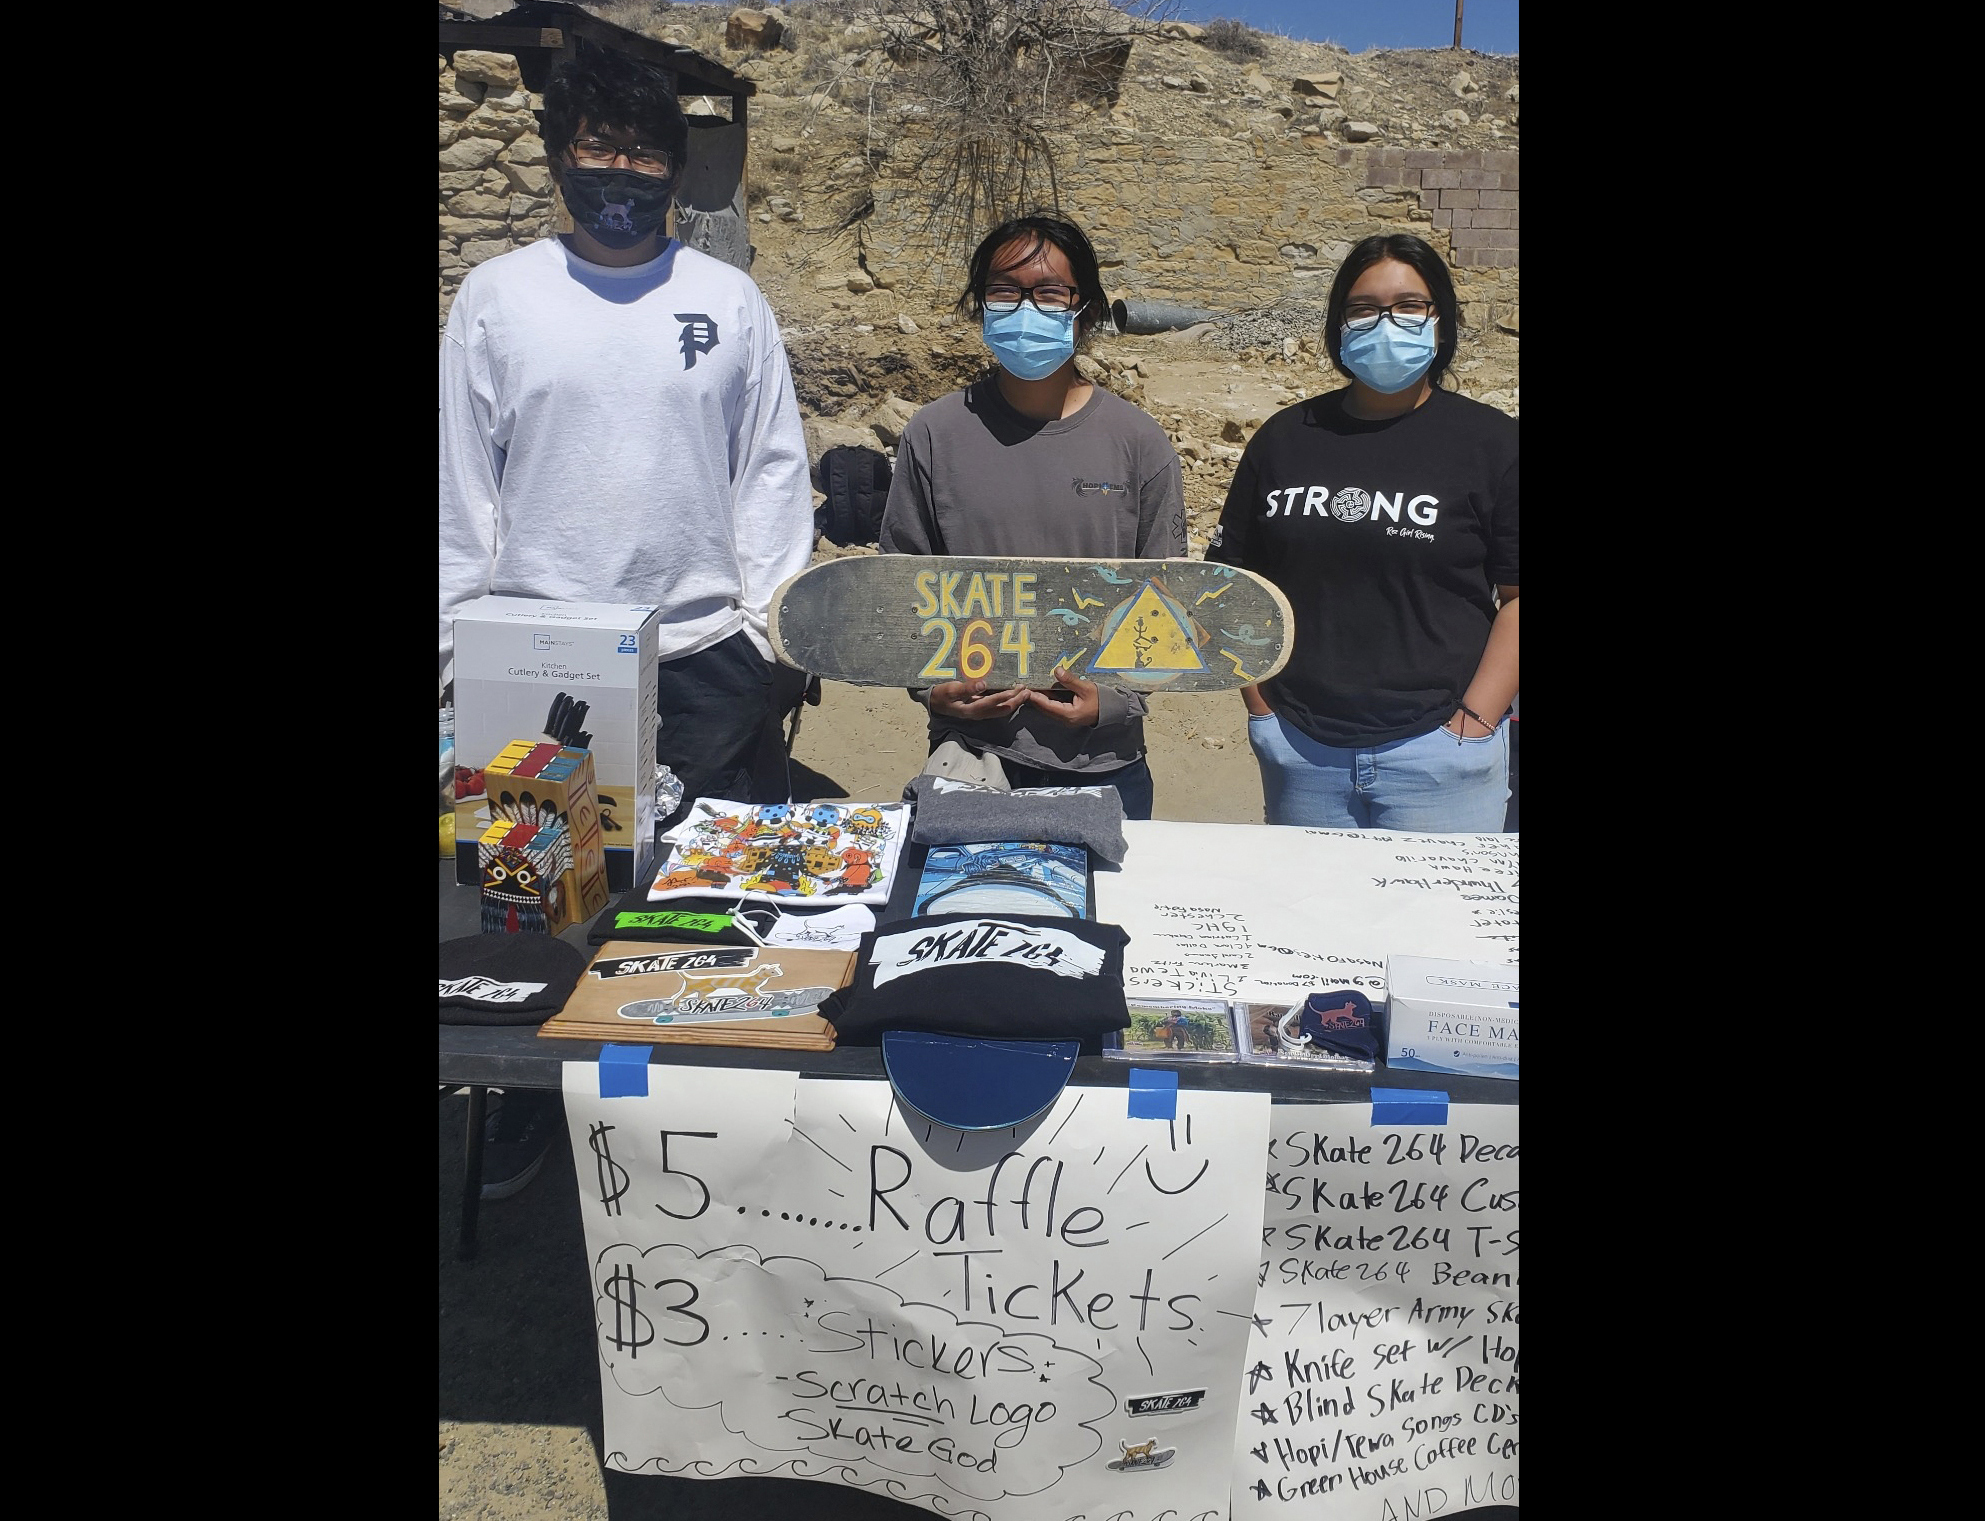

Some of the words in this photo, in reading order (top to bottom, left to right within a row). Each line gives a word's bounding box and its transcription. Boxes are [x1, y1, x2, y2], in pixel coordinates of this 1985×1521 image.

[1266, 485, 1440, 526] STRONG
[914, 569, 1038, 620] SKATE
[620, 634, 635, 646] 23
[917, 618, 1036, 681] 264
[508, 667, 540, 678] Cutlery
[542, 670, 549, 678] &
[551, 671, 584, 681] Gadget
[586, 673, 600, 681] Set
[541, 662, 567, 670] Kitchen
[896, 922, 1022, 966] SKATE
[615, 952, 688, 975] SKATE
[681, 954, 717, 969] 264
[1428, 1020, 1481, 1037] FACE
[1488, 1026, 1518, 1041] MA
[1401, 1047, 1415, 1058] 50
[1382, 1133, 1447, 1166] 264
[869, 1144, 1110, 1247] Raffle
[1388, 1179, 1450, 1212] 264
[1387, 1225, 1450, 1252] 264
[1356, 1261, 1411, 1284] 264
[1280, 1303, 1312, 1336] 7
[1317, 1300, 1400, 1340] layer
[1407, 1297, 1476, 1329] Army
[1284, 1348, 1356, 1388] Knife
[1139, 1394, 1178, 1411] SKATE
[1283, 1386, 1356, 1426] Blind
[970, 1394, 1057, 1449] Logo
[928, 1437, 998, 1474] God
[1277, 1473, 1343, 1502] Green
[1348, 1457, 1408, 1491] House
[1414, 1437, 1477, 1471] Coffee
[1381, 1486, 1448, 1521] AND
[1464, 1471, 1518, 1506] MO
